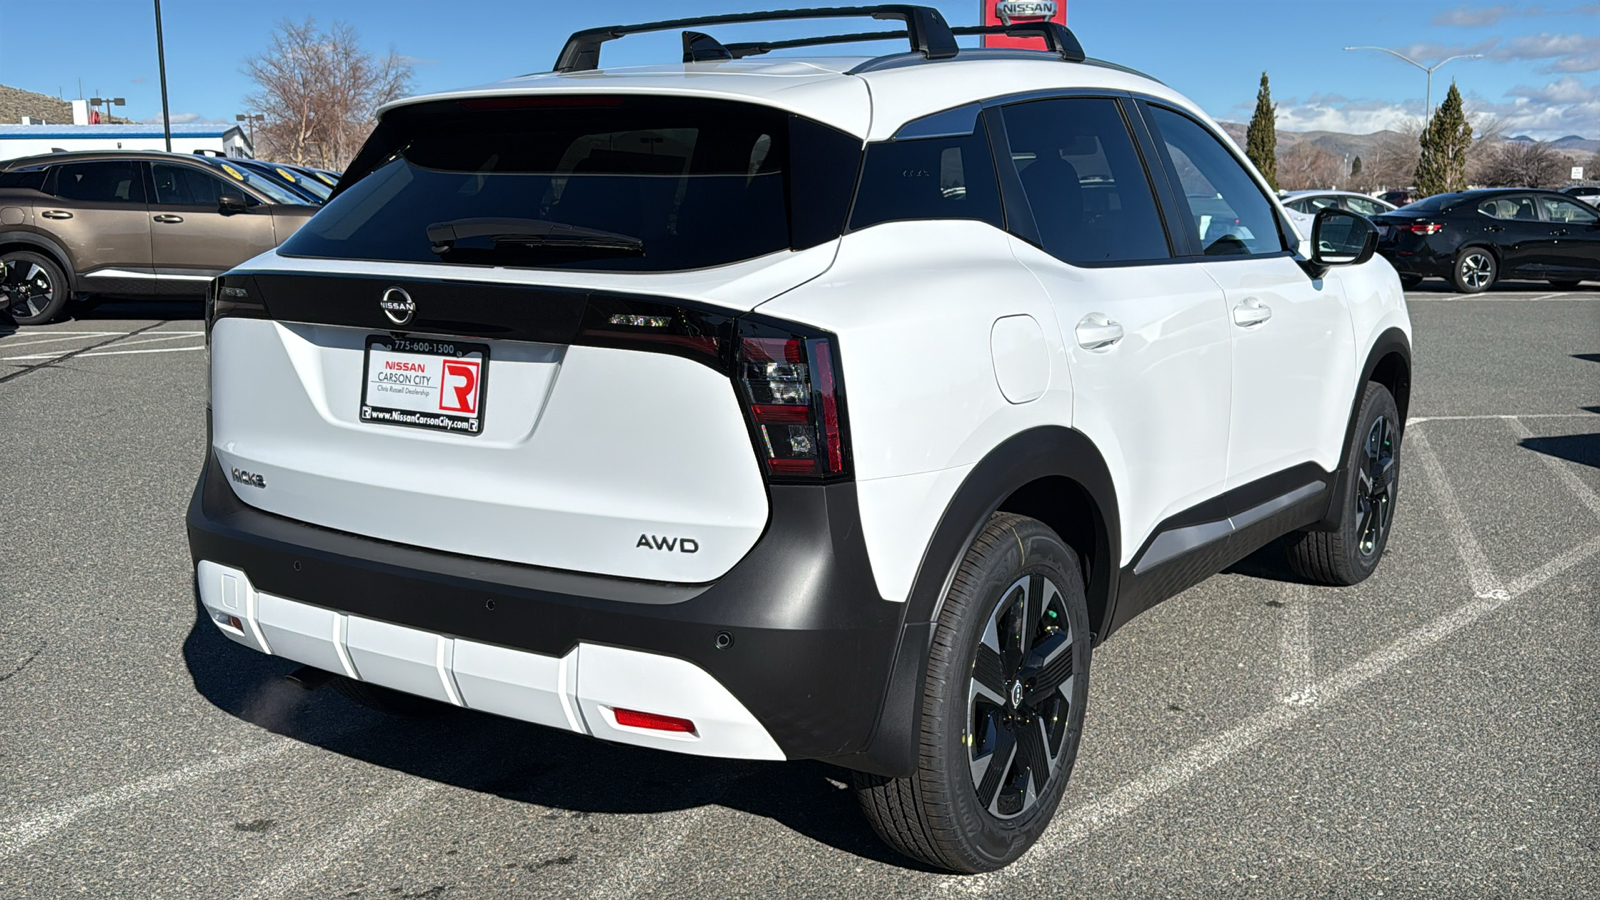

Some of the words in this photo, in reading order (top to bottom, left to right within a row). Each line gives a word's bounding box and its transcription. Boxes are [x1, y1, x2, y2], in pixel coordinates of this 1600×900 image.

[1003, 3, 1053, 13] NISSAN
[382, 302, 414, 311] NISSAN
[394, 340, 455, 354] 775-600-1500
[385, 360, 426, 373] NISSAN
[377, 371, 412, 385] CARSON
[413, 375, 432, 386] CITY
[377, 384, 389, 393] Chris
[389, 386, 405, 395] Russell
[405, 387, 430, 397] Dealership
[447, 365, 474, 411] R
[371, 410, 469, 430] www.NissanCarsonCity.com
[231, 466, 267, 489] KICKS
[635, 533, 699, 554] AWD
